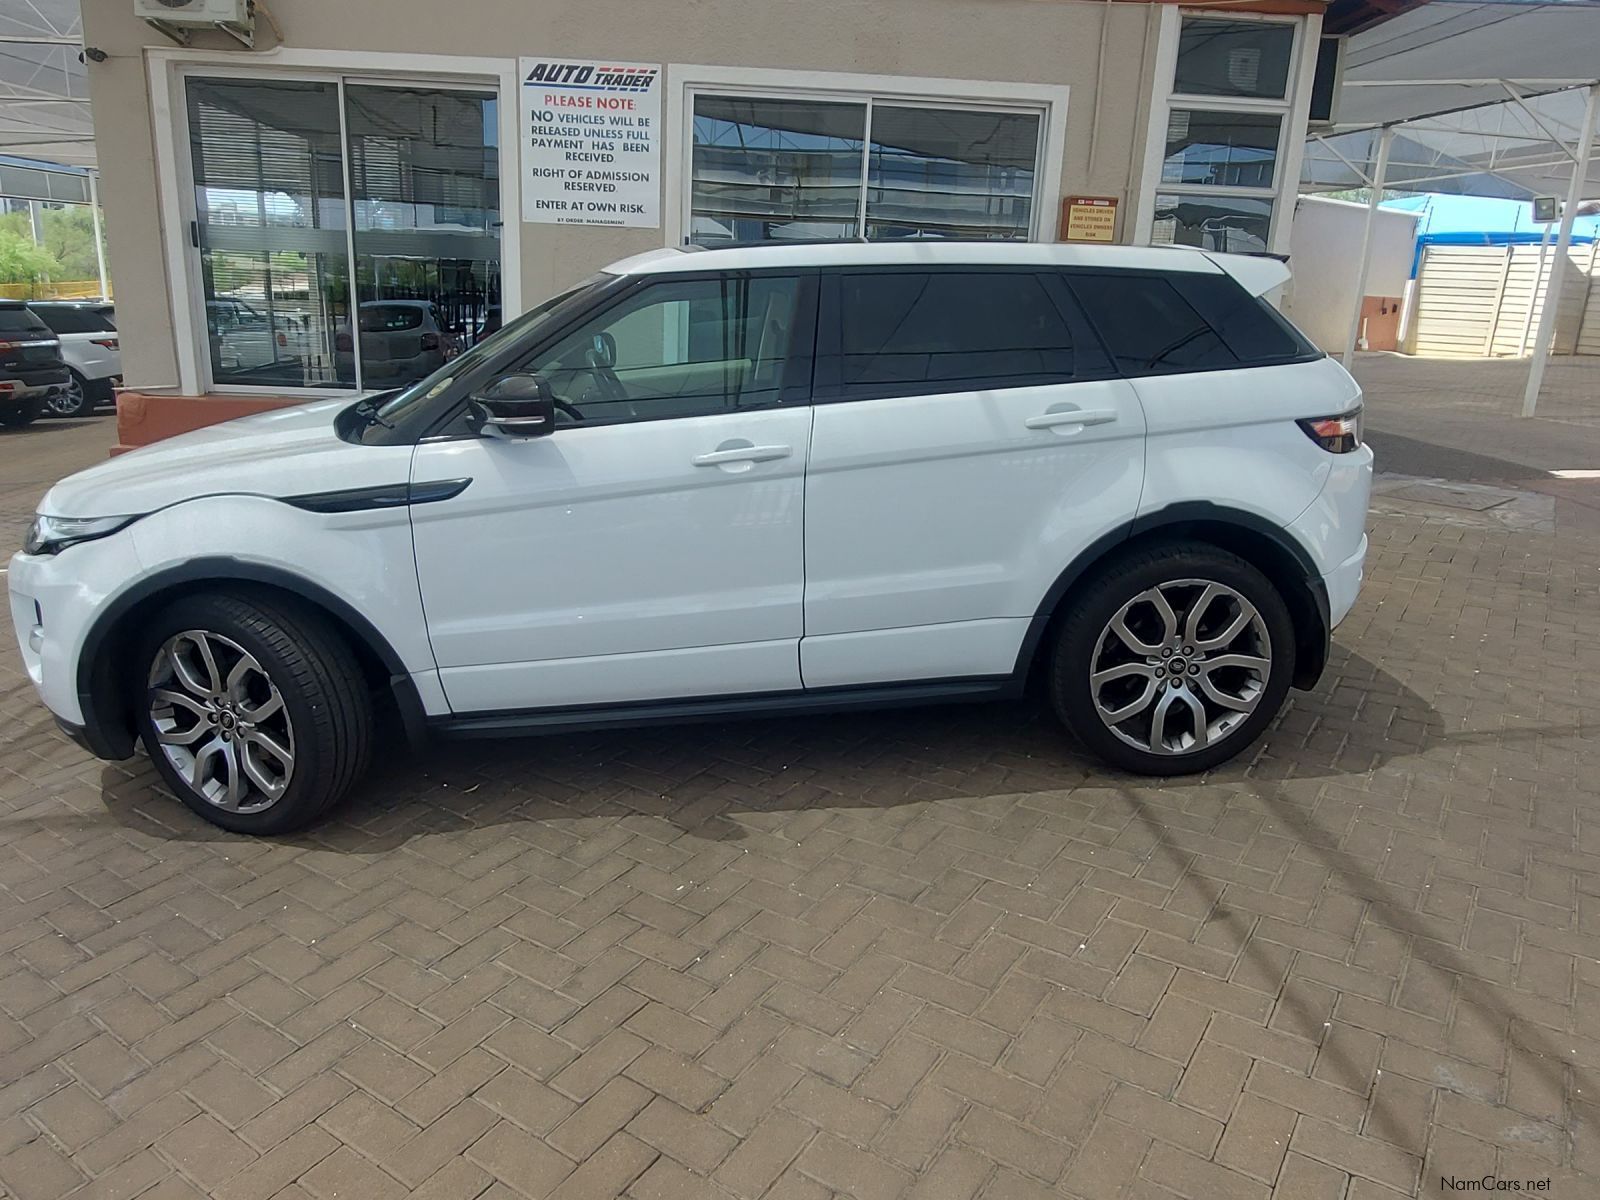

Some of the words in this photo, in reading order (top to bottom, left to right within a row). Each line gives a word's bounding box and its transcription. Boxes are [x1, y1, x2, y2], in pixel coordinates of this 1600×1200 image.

[526, 64, 594, 83] AUTO
[594, 73, 654, 87] TRADER
[545, 95, 592, 107] PLEASE
[597, 98, 636, 110] NOTE:
[531, 110, 553, 122] NO
[558, 113, 605, 125] VEHICLES
[609, 116, 633, 126] WILL
[638, 118, 650, 127] BE
[532, 126, 580, 136] RELEASED
[584, 129, 623, 139] UNLESS
[627, 131, 649, 140] FULL
[531, 138, 584, 149] PAYMENT
[592, 141, 614, 150] HAS
[623, 143, 649, 152] BEEN
[532, 168, 565, 178] RIGHT
[568, 170, 582, 179] OF
[586, 171, 649, 182] ADMISSION
[536, 200, 567, 210] ENTER
[571, 202, 584, 211] AT
[587, 203, 616, 212] OWN
